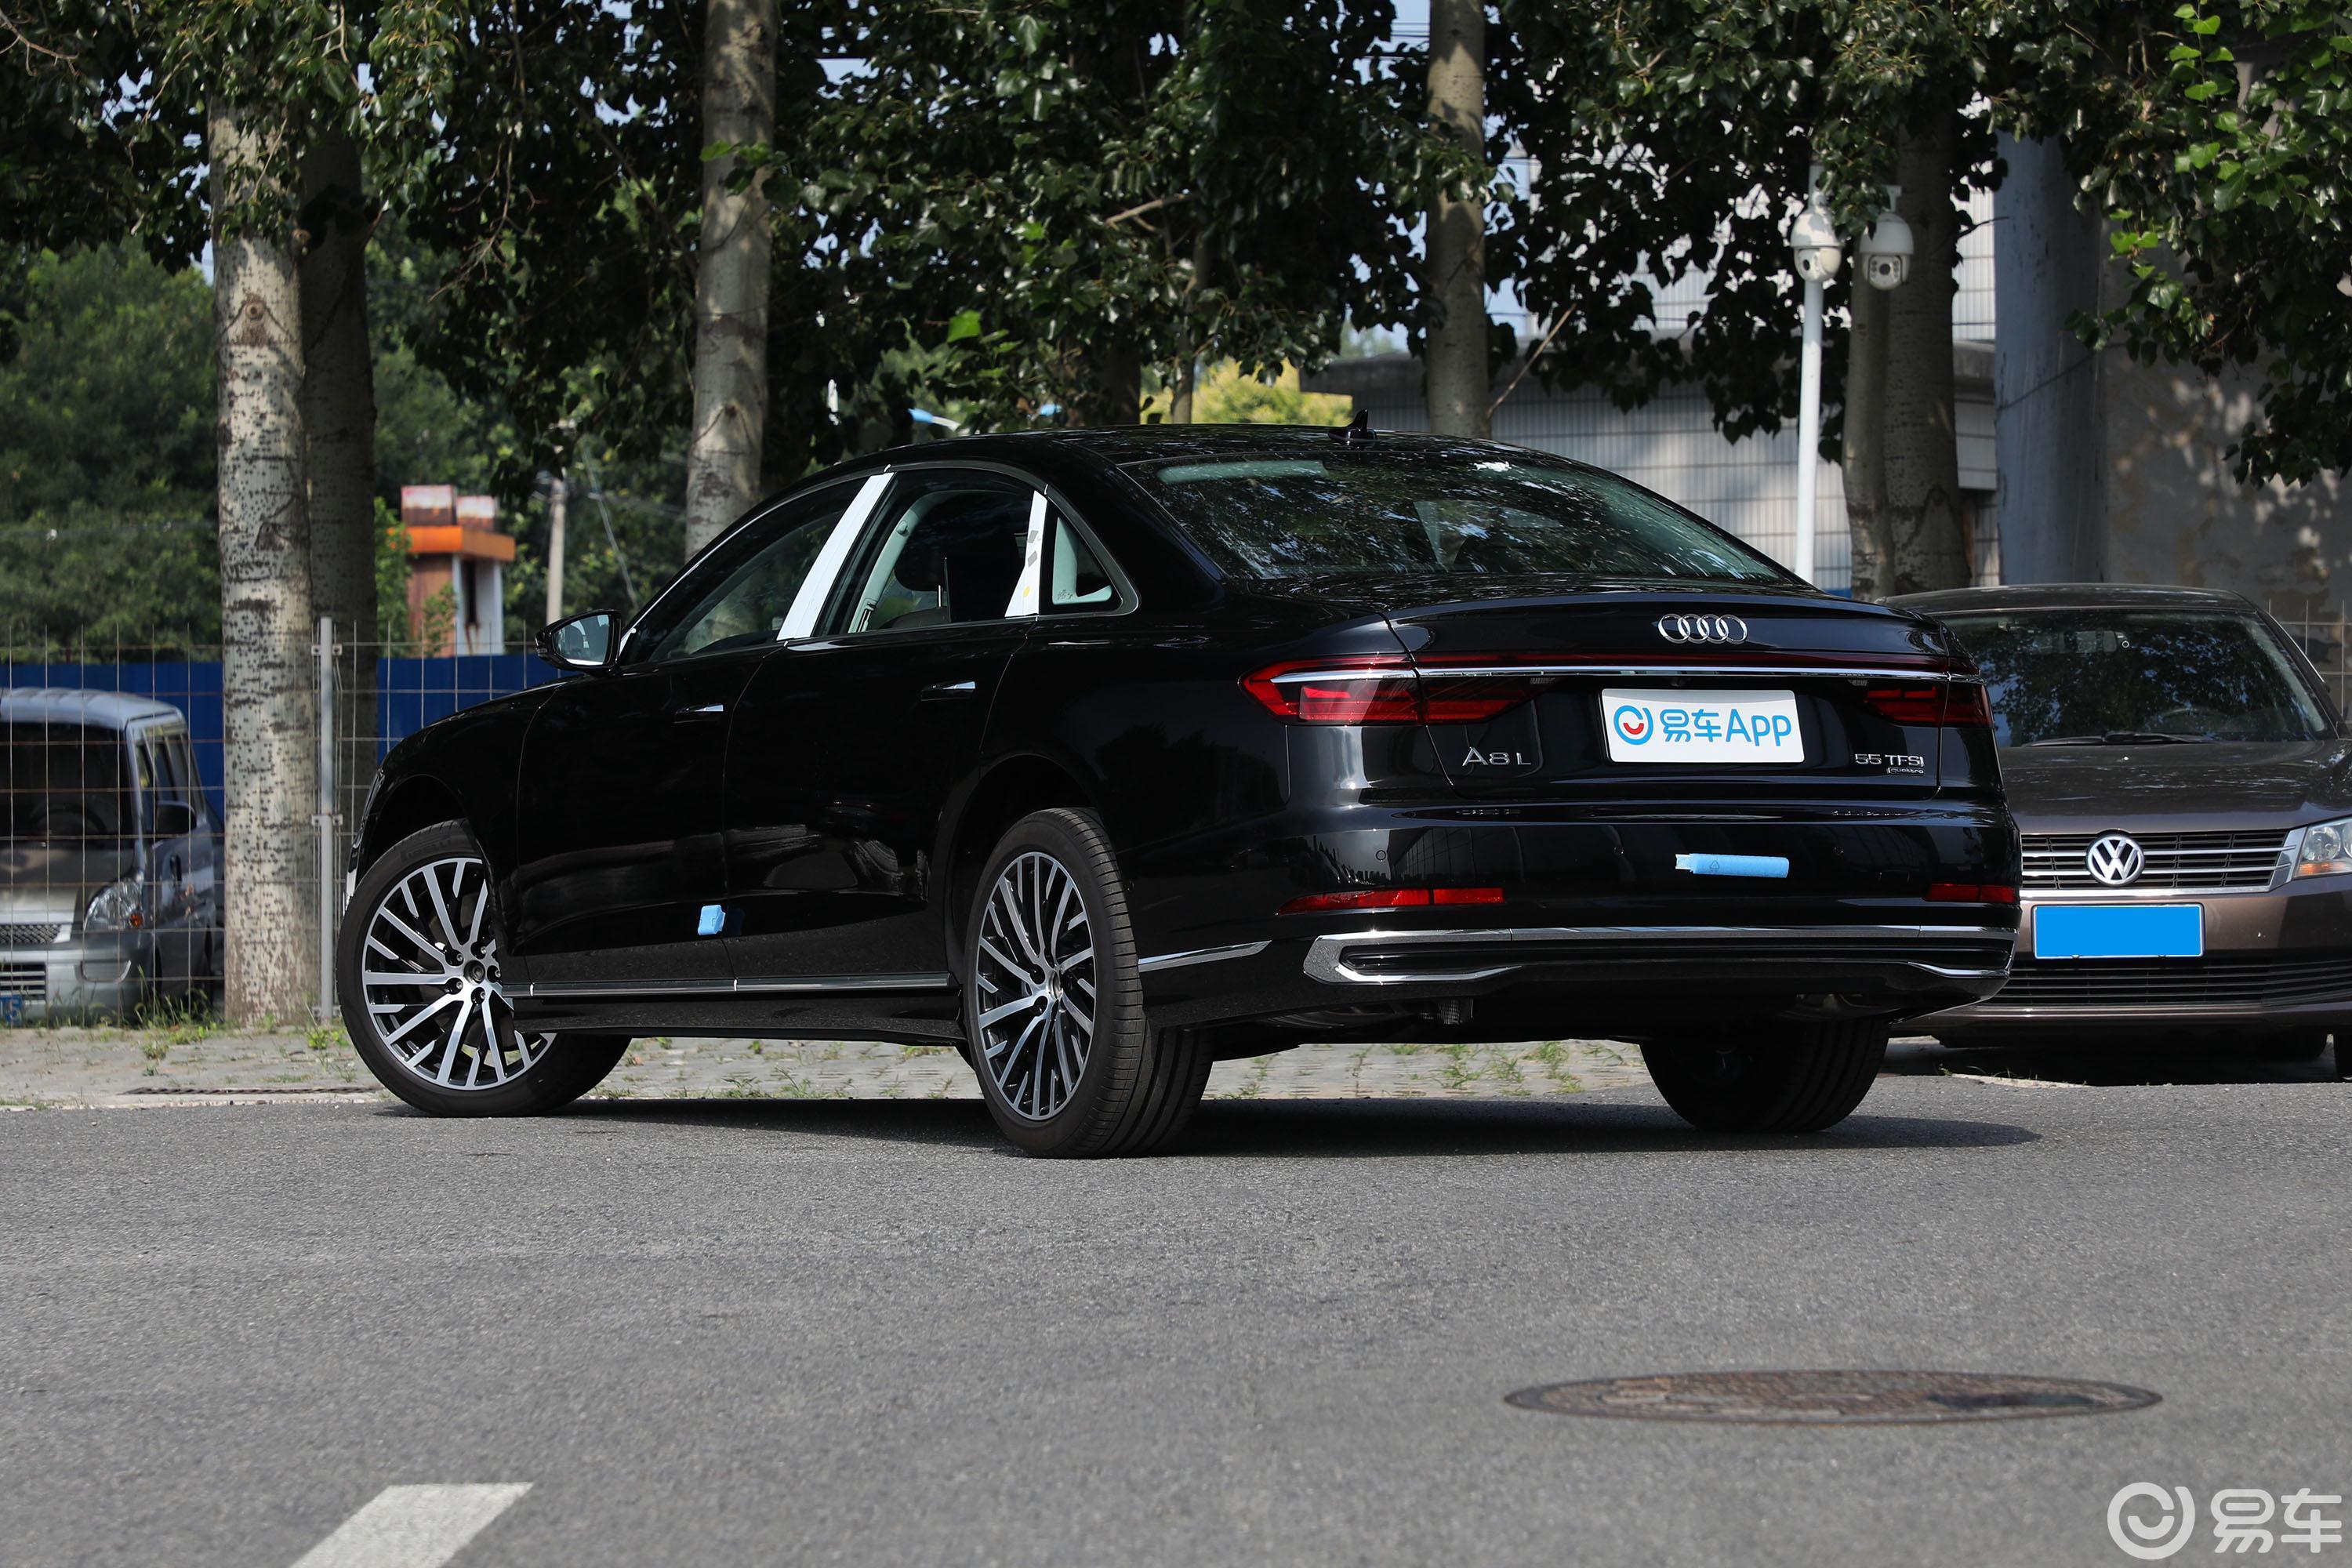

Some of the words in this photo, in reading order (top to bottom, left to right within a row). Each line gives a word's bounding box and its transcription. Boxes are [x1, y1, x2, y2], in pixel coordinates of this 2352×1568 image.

[1659, 709, 1792, 746] 易车App
[1462, 746, 1510, 766] A8
[1516, 752, 1532, 765] L
[1854, 753, 1882, 764] 55
[1885, 754, 1925, 768] TFSI
